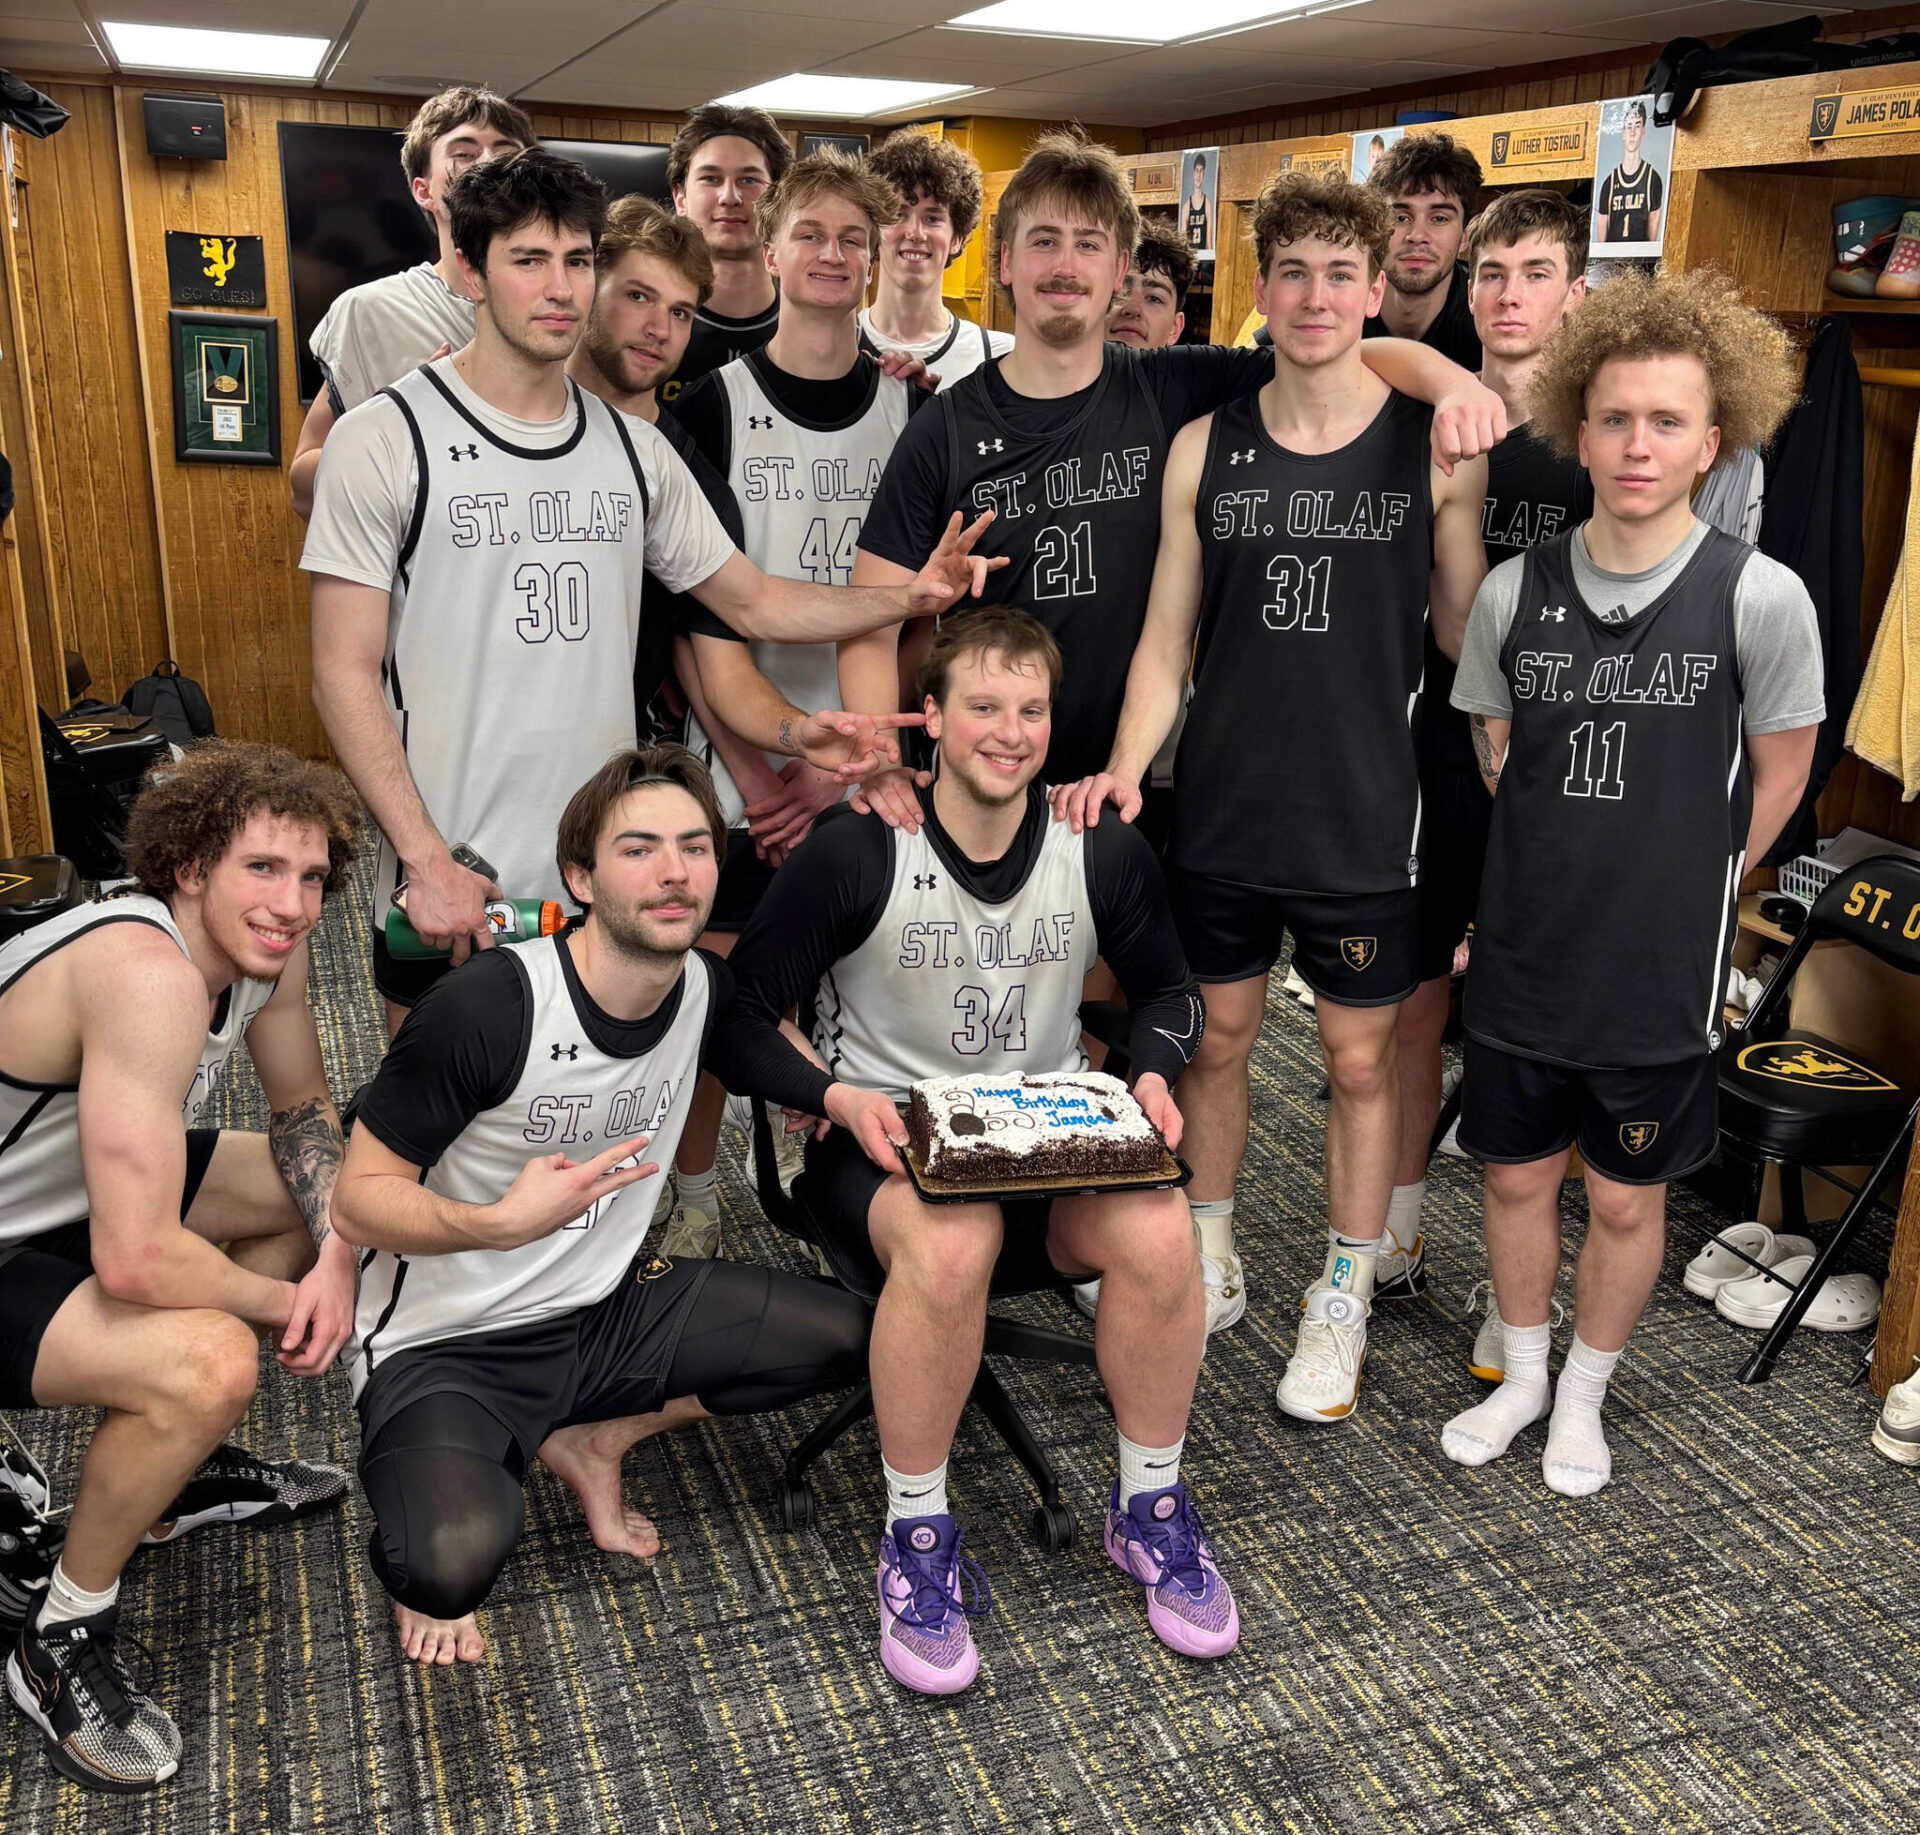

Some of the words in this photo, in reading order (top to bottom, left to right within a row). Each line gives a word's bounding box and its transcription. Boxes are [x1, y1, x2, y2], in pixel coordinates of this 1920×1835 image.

[1849, 55, 1880, 67] UNDER
[1846, 102, 1887, 125] JAMES
[1889, 99, 1920, 120] POLA
[1512, 138, 1541, 155] LUTHER
[1544, 134, 1580, 153] TOSTRUD
[1613, 195, 1624, 211] ST.
[1625, 193, 1645, 209] OLAF
[1622, 213, 1630, 237] 1
[182, 287, 202, 300] GO
[743, 457, 804, 501] ST.
[812, 458, 885, 501] OLA
[972, 472, 1036, 522] ST.
[1045, 446, 1150, 509] OLAF
[448, 493, 519, 547] ST.
[531, 491, 632, 544] OLAF
[1212, 490, 1274, 540] ST.
[1287, 490, 1410, 540] OLAF
[1482, 498, 1566, 547] LAF
[799, 517, 862, 585] 44
[1034, 521, 1096, 600] 21
[514, 561, 590, 643] 30
[1263, 555, 1333, 631] 31
[1514, 651, 1574, 702] ST.
[1587, 653, 1717, 706] OLAF
[1564, 721, 1626, 800] 11
[1843, 881, 1892, 930] ST.
[900, 922, 964, 968] ST.
[975, 911, 1075, 969] OLAF
[951, 985, 1027, 1055] 34
[523, 1095, 593, 1143] ST.
[604, 1076, 684, 1138] OLA
[973, 1087, 1022, 1098] Happy
[1011, 1095, 1089, 1112] Birthday
